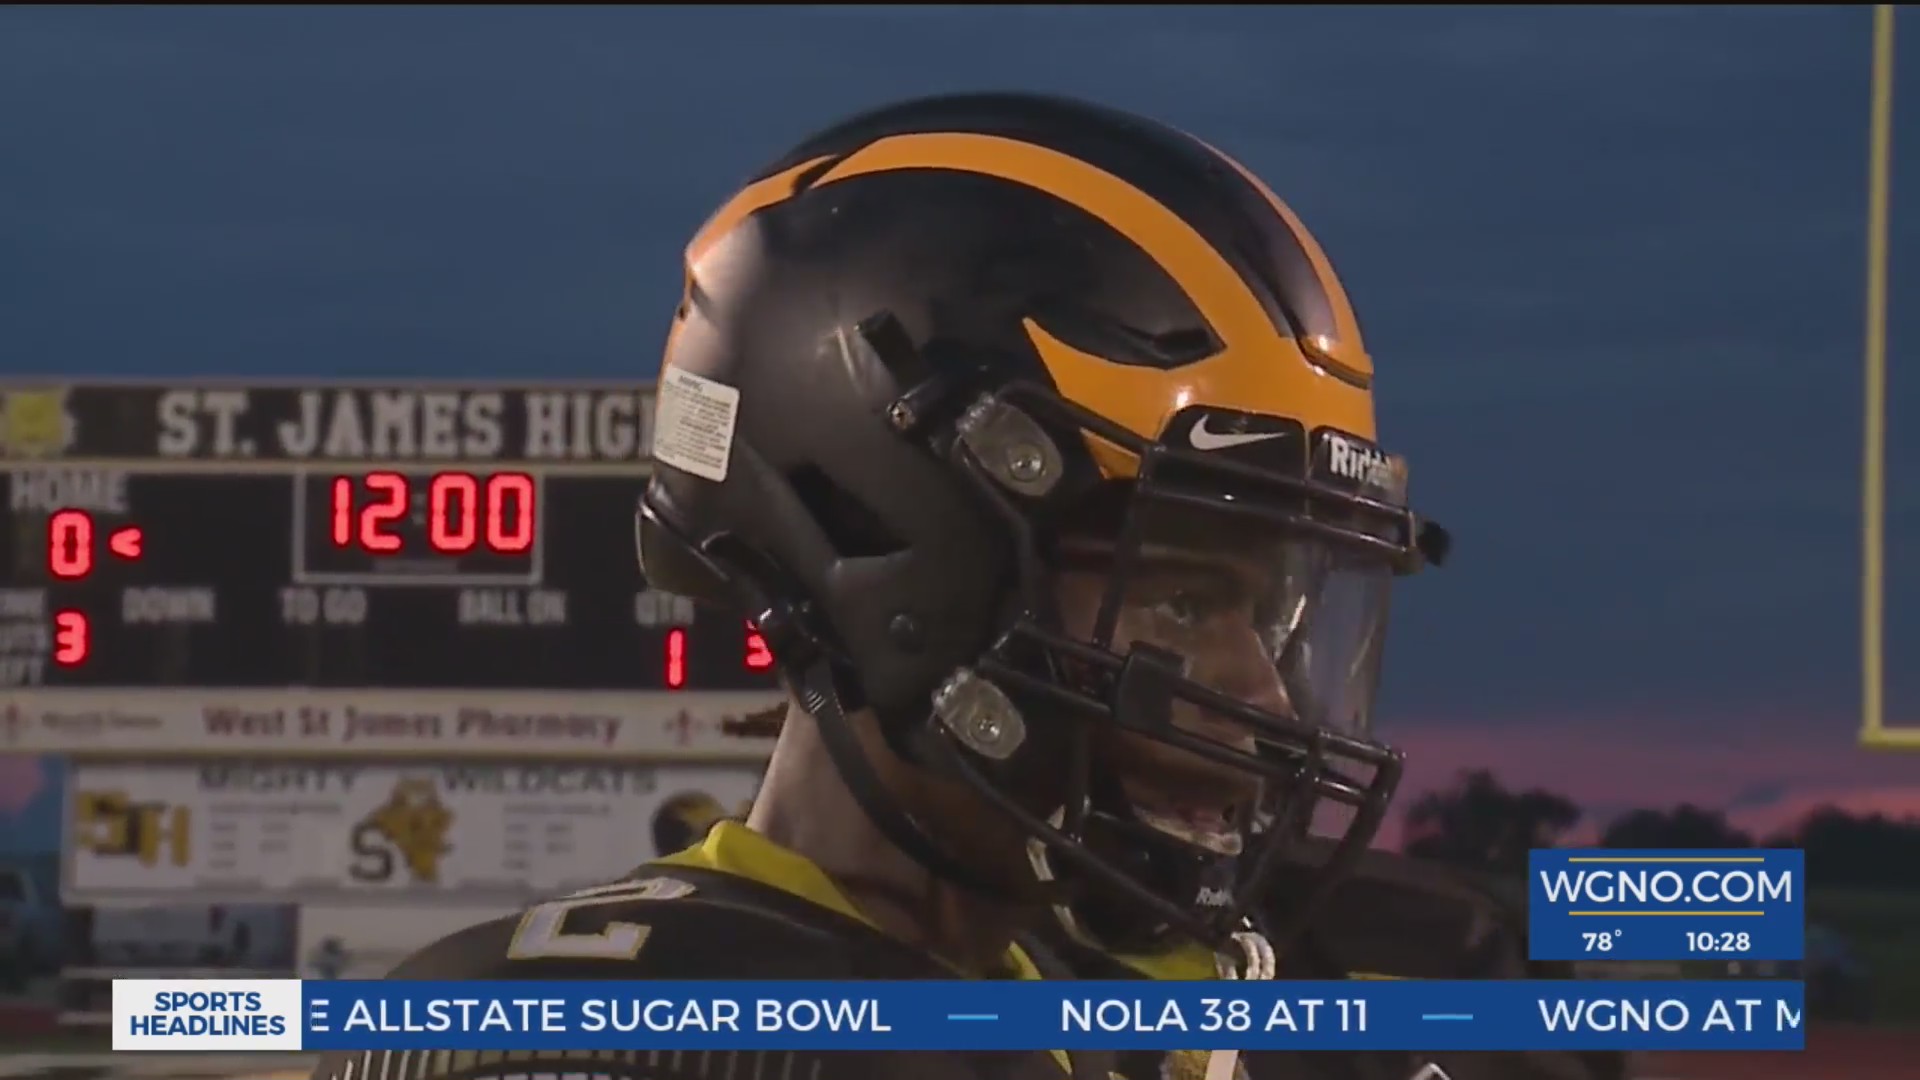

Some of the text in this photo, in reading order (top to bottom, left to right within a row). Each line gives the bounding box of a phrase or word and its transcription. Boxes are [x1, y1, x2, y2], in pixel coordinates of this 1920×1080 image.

[157, 391, 256, 455] ST.
[277, 391, 502, 456] JAMES
[10, 472, 129, 513] HOME
[50, 511, 92, 577] 0
[122, 587, 215, 622] DOWN
[280, 588, 367, 624] TO GO
[458, 589, 566, 624] BALL ON
[56, 611, 87, 664] 3
[667, 629, 684, 687] 1
[203, 707, 285, 736] West
[298, 706, 330, 736] St
[342, 704, 443, 743] James
[457, 706, 625, 745] Pharmacy
